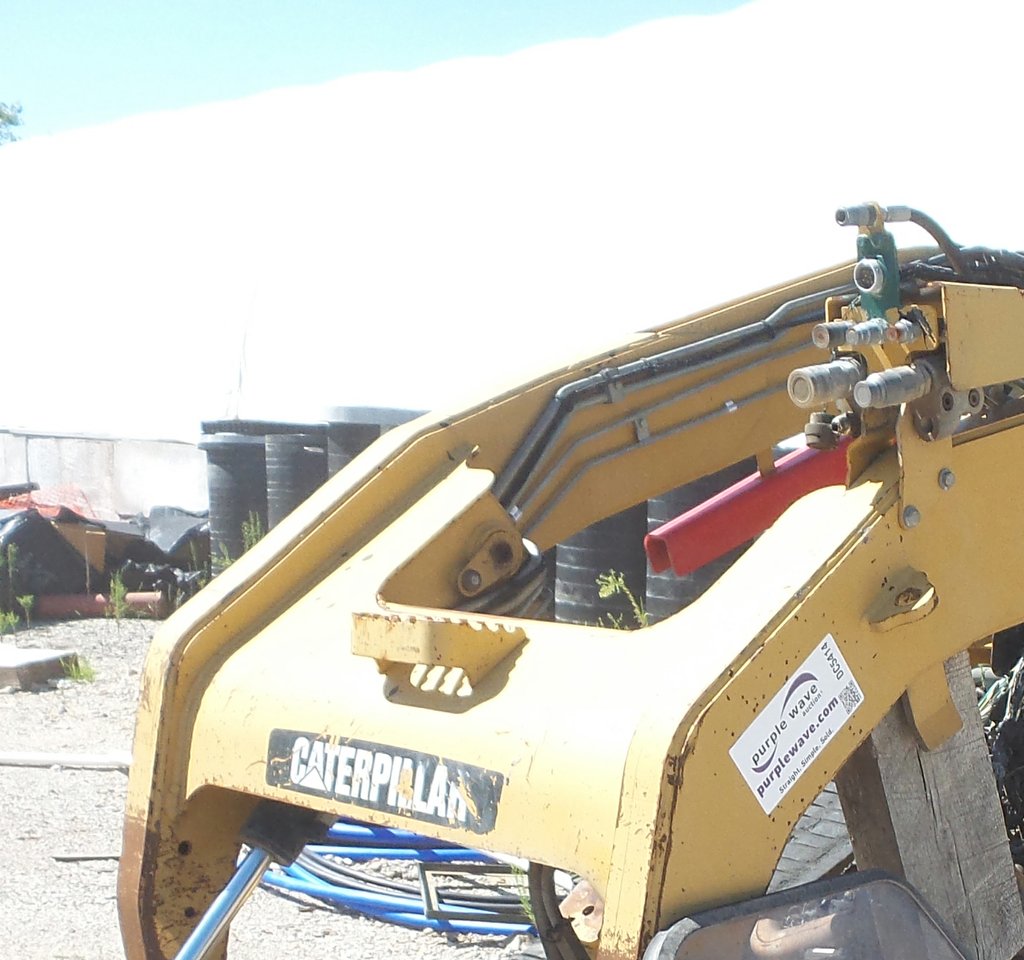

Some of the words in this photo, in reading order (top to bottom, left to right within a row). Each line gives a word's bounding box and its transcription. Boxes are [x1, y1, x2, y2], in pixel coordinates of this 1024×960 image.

[821, 641, 844, 681] DC5414
[751, 719, 788, 766] purple
[788, 683, 819, 720] wave
[756, 696, 840, 799] purplewave.com
[800, 745, 822, 768] Simple.
[819, 728, 834, 745] Sold.
